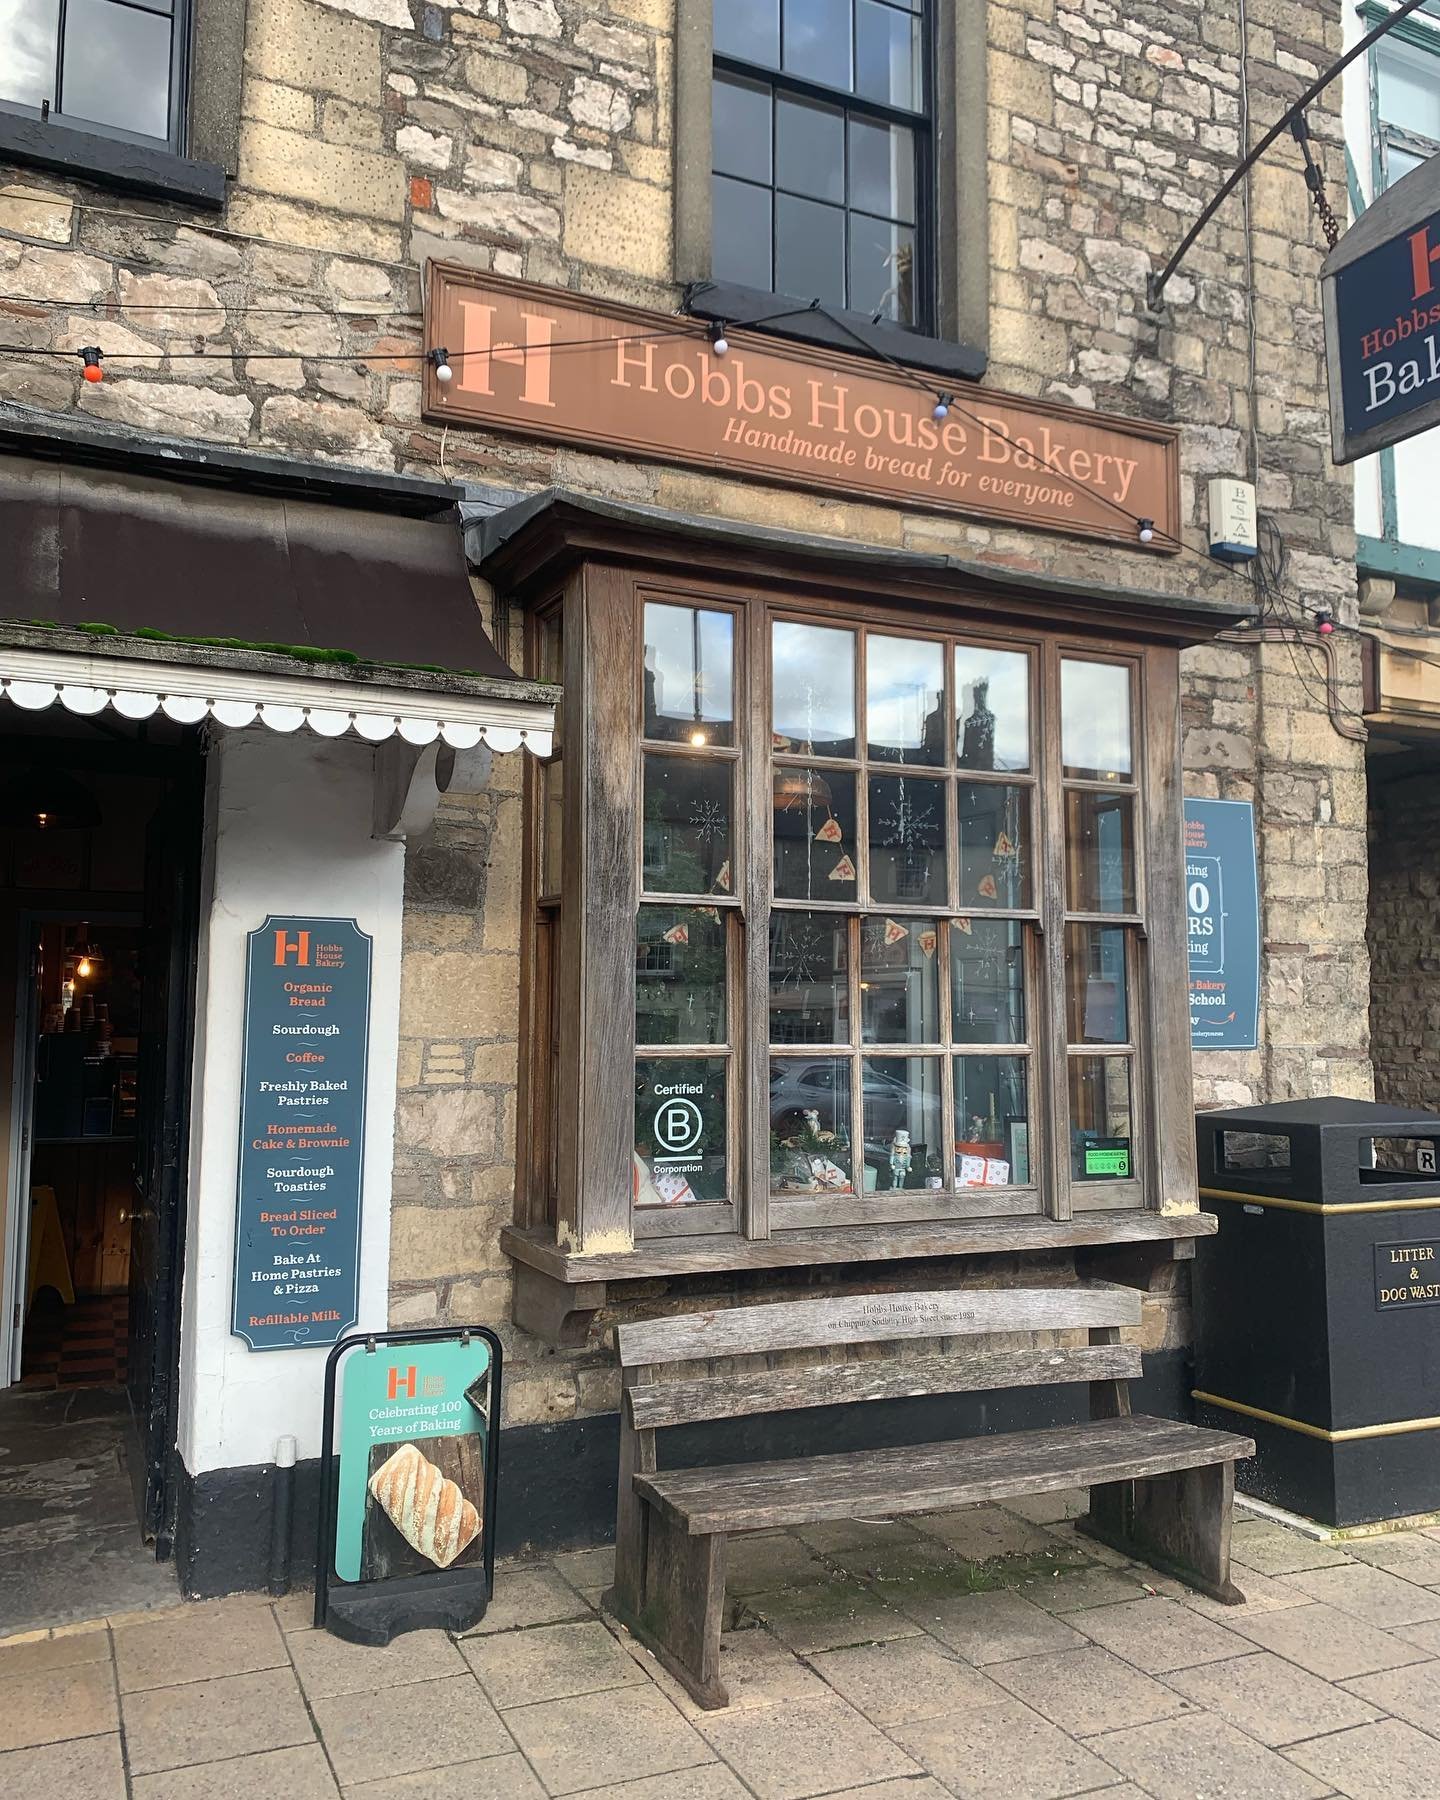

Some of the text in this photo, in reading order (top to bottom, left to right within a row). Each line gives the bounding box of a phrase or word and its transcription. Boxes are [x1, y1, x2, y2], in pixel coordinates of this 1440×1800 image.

[1361, 304, 1440, 360] Hobbs
[456, 300, 557, 407] H
[610, 334, 1138, 502] Hobbs House Bakery
[722, 417, 1075, 508] Handmade bread for everyone
[1185, 864, 1208, 878] ting
[273, 930, 311, 967] H
[316, 944, 343, 952] Hobbs
[316, 952, 342, 960] House
[315, 959, 345, 968] Bakery
[284, 982, 332, 994] Organic
[1196, 980, 1226, 992] Bakery
[289, 997, 325, 1007] Bread
[1189, 993, 1226, 1006] School
[272, 1025, 340, 1036] Sourdough
[286, 1053, 325, 1063] Coffee
[259, 1080, 348, 1093] Freshly Baked
[654, 1084, 703, 1095] Certified
[277, 1095, 329, 1106] Pastries
[267, 1124, 337, 1135] Homemade
[668, 1109, 691, 1141] B
[252, 1138, 350, 1150] Cake & Brownie
[1422, 1152, 1434, 1170] R
[267, 1165, 334, 1178] Sourdough
[653, 1164, 703, 1174] Corporation
[274, 1181, 326, 1192] Toasties
[260, 1209, 337, 1223] Bread Sliced
[271, 1225, 326, 1237] To Order
[273, 1254, 321, 1266] Bake At
[1390, 1247, 1435, 1263] LITTER
[251, 1267, 342, 1282] Home Pastries
[1410, 1267, 1419, 1279] &
[273, 1284, 320, 1295] & Pizza
[1380, 1287, 1407, 1303] DOG
[862, 1304, 887, 1314] Hobbs
[889, 1303, 912, 1313] House
[249, 1311, 340, 1327] Refillable Milk
[387, 1366, 417, 1401] H
[369, 1401, 462, 1420] Celebrating 100
[369, 1419, 461, 1437] Years of Baking
